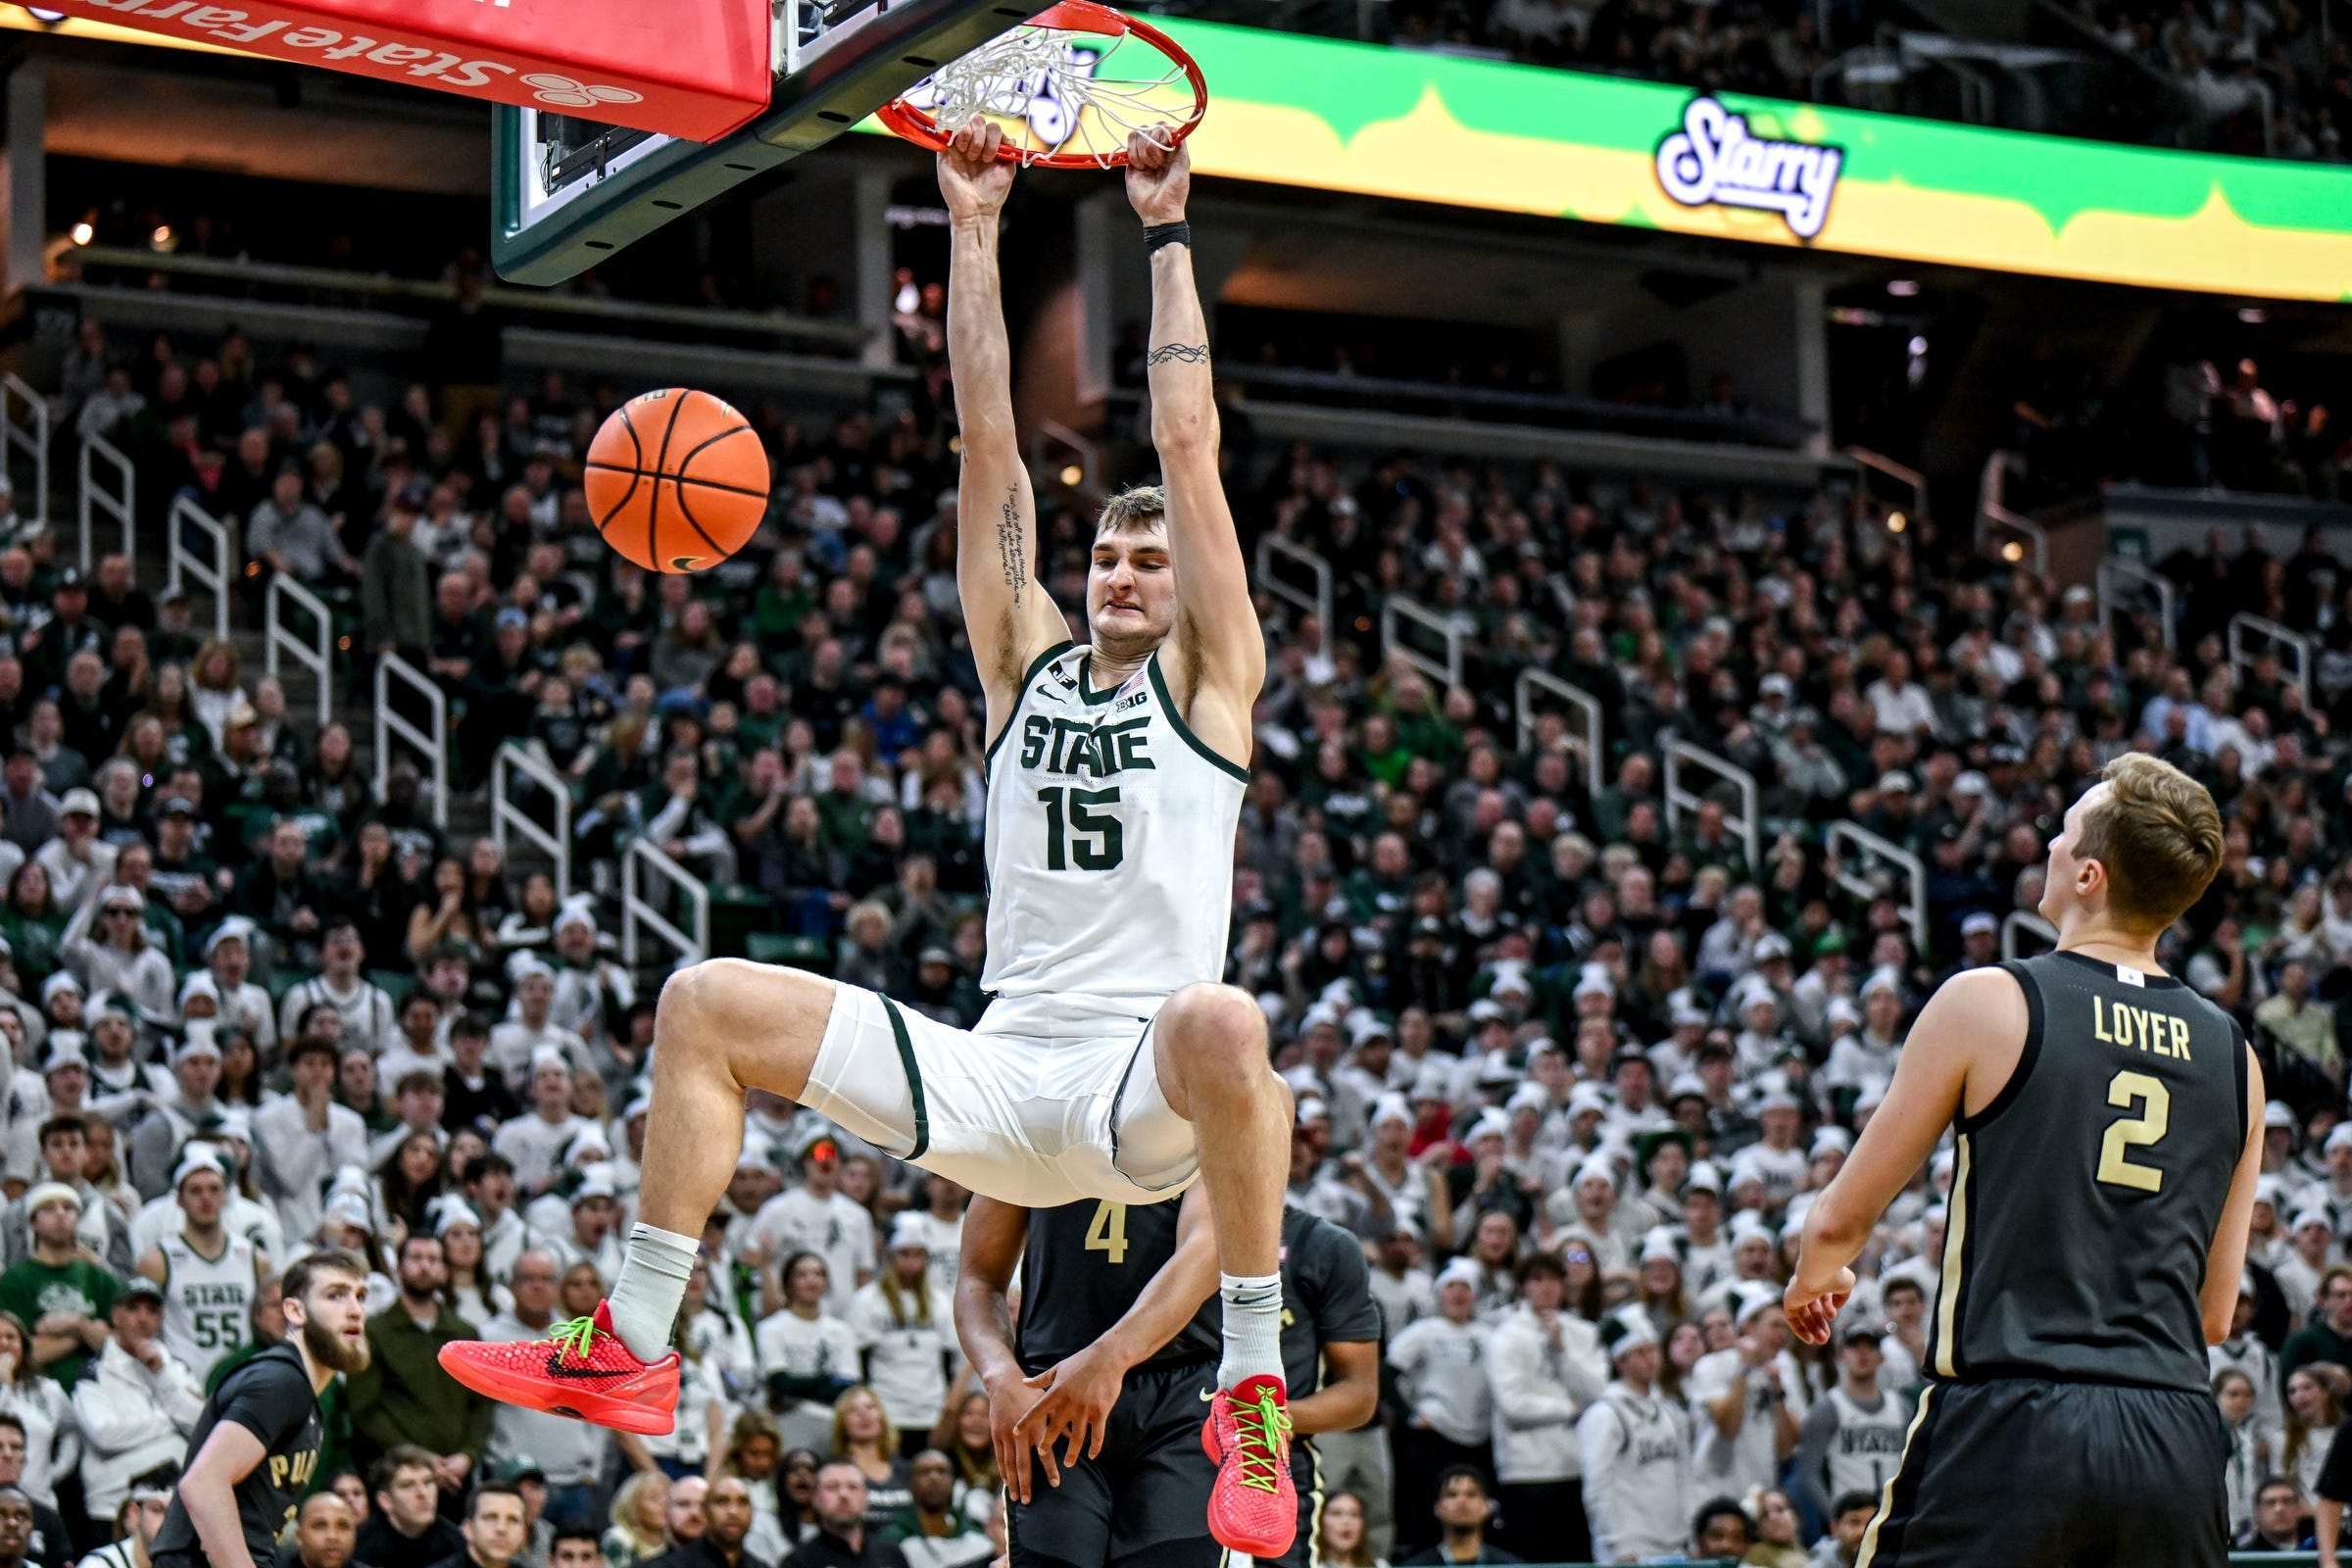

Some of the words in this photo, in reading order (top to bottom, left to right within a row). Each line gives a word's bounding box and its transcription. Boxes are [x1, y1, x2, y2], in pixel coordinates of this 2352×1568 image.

[1655, 96, 1843, 237] Starry
[1017, 558, 1027, 589] through
[1020, 714, 1156, 778] STATE
[1037, 786, 1124, 871] 15
[2093, 995, 2191, 1061] LOYER
[2096, 1069, 2171, 1193] 2
[1085, 1199, 1129, 1263] 4
[195, 1311, 242, 1351] 55
